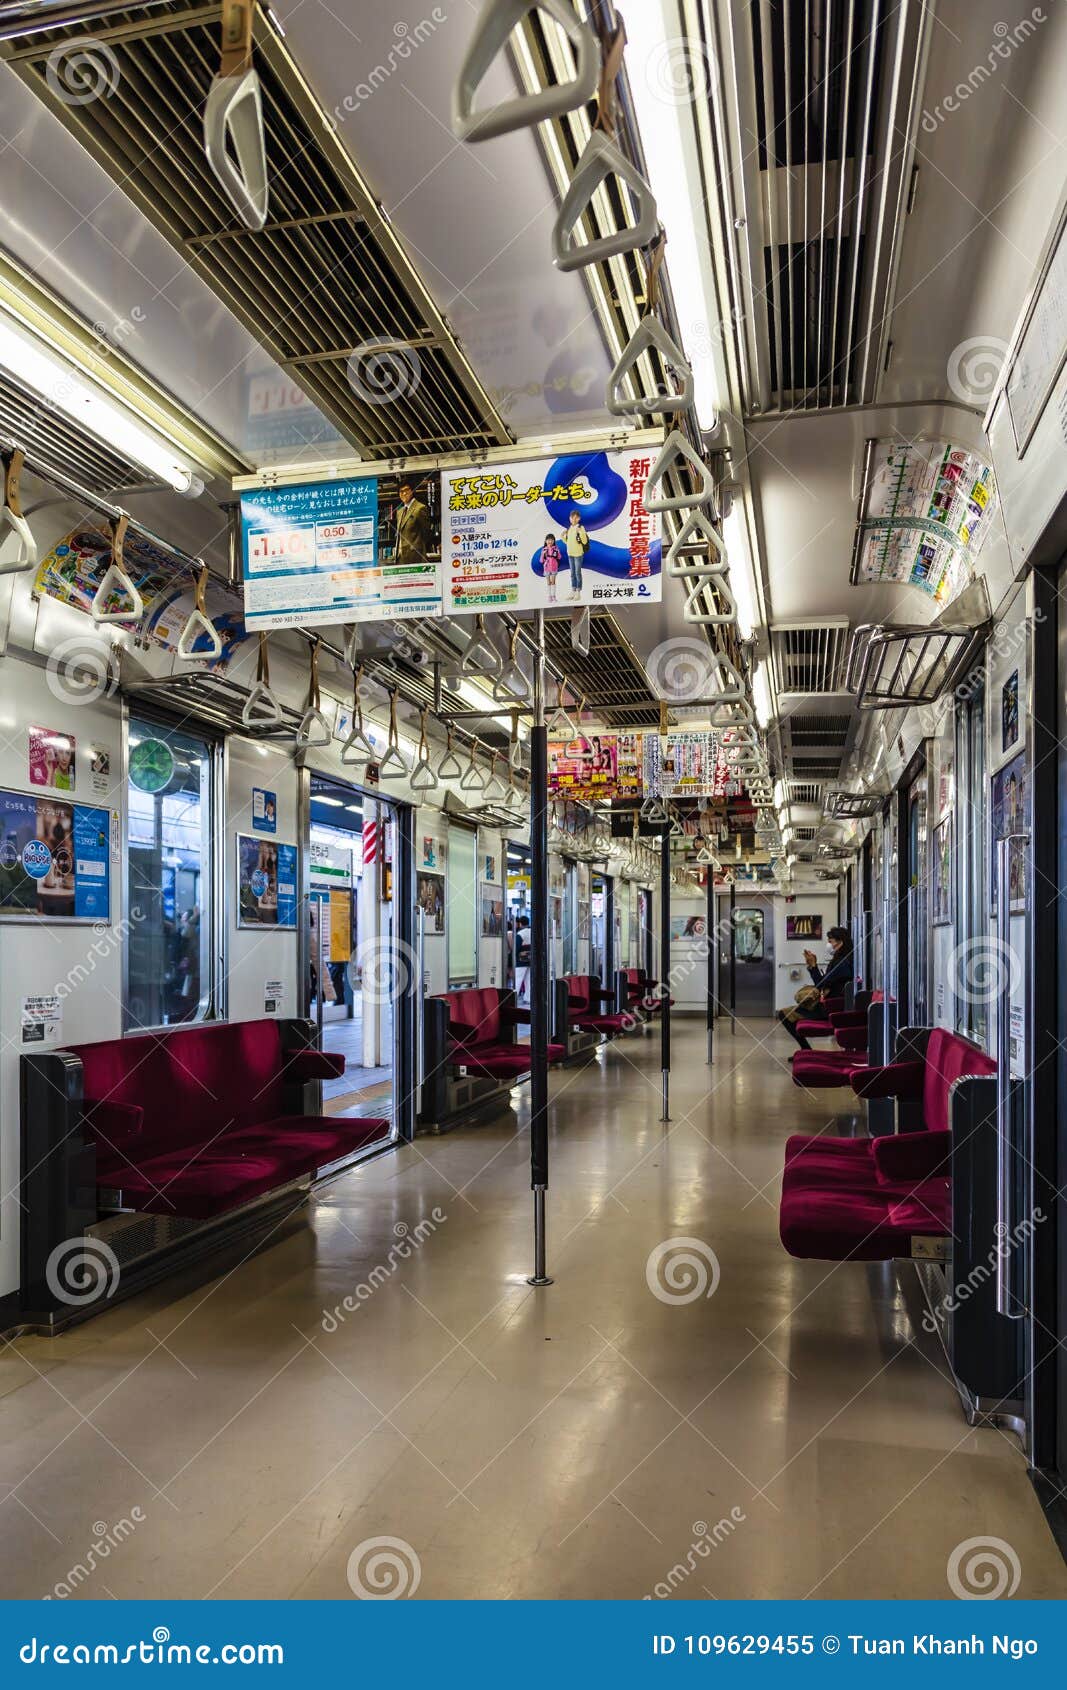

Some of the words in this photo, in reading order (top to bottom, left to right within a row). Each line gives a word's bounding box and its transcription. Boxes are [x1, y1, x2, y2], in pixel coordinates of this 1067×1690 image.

[450, 474, 518, 494] でてこい、
[449, 483, 591, 510] 未来のリーダーたち。
[593, 588, 634, 598] 四谷大塚
